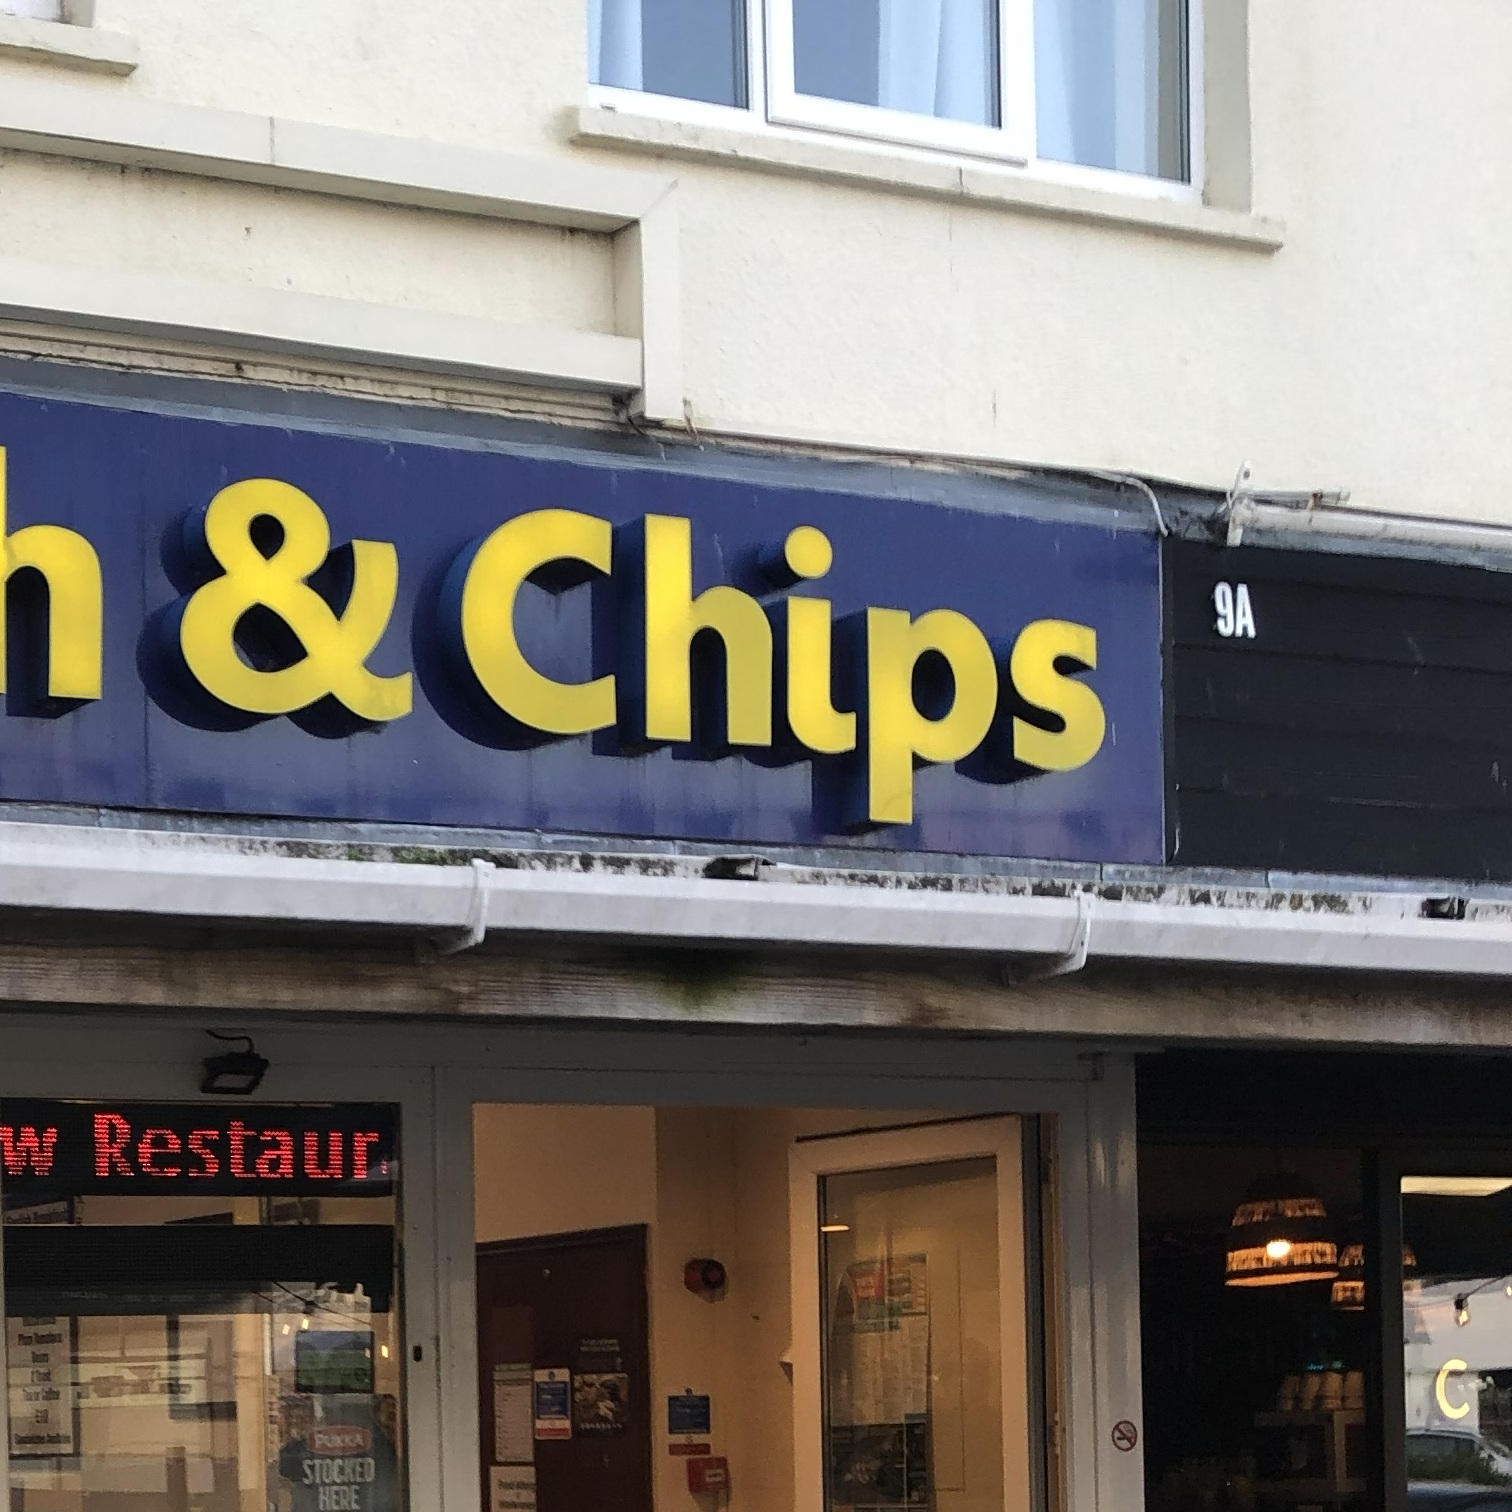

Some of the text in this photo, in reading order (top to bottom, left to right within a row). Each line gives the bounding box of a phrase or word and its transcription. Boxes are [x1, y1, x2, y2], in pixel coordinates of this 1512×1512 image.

[1213, 580, 1256, 640] 9A
[179, 477, 414, 723] &
[461, 508, 1106, 825] Chips
[92, 1112, 388, 1180] Restaur
[302, 1456, 376, 1485] STOCKED
[317, 1484, 361, 1512] HERE
